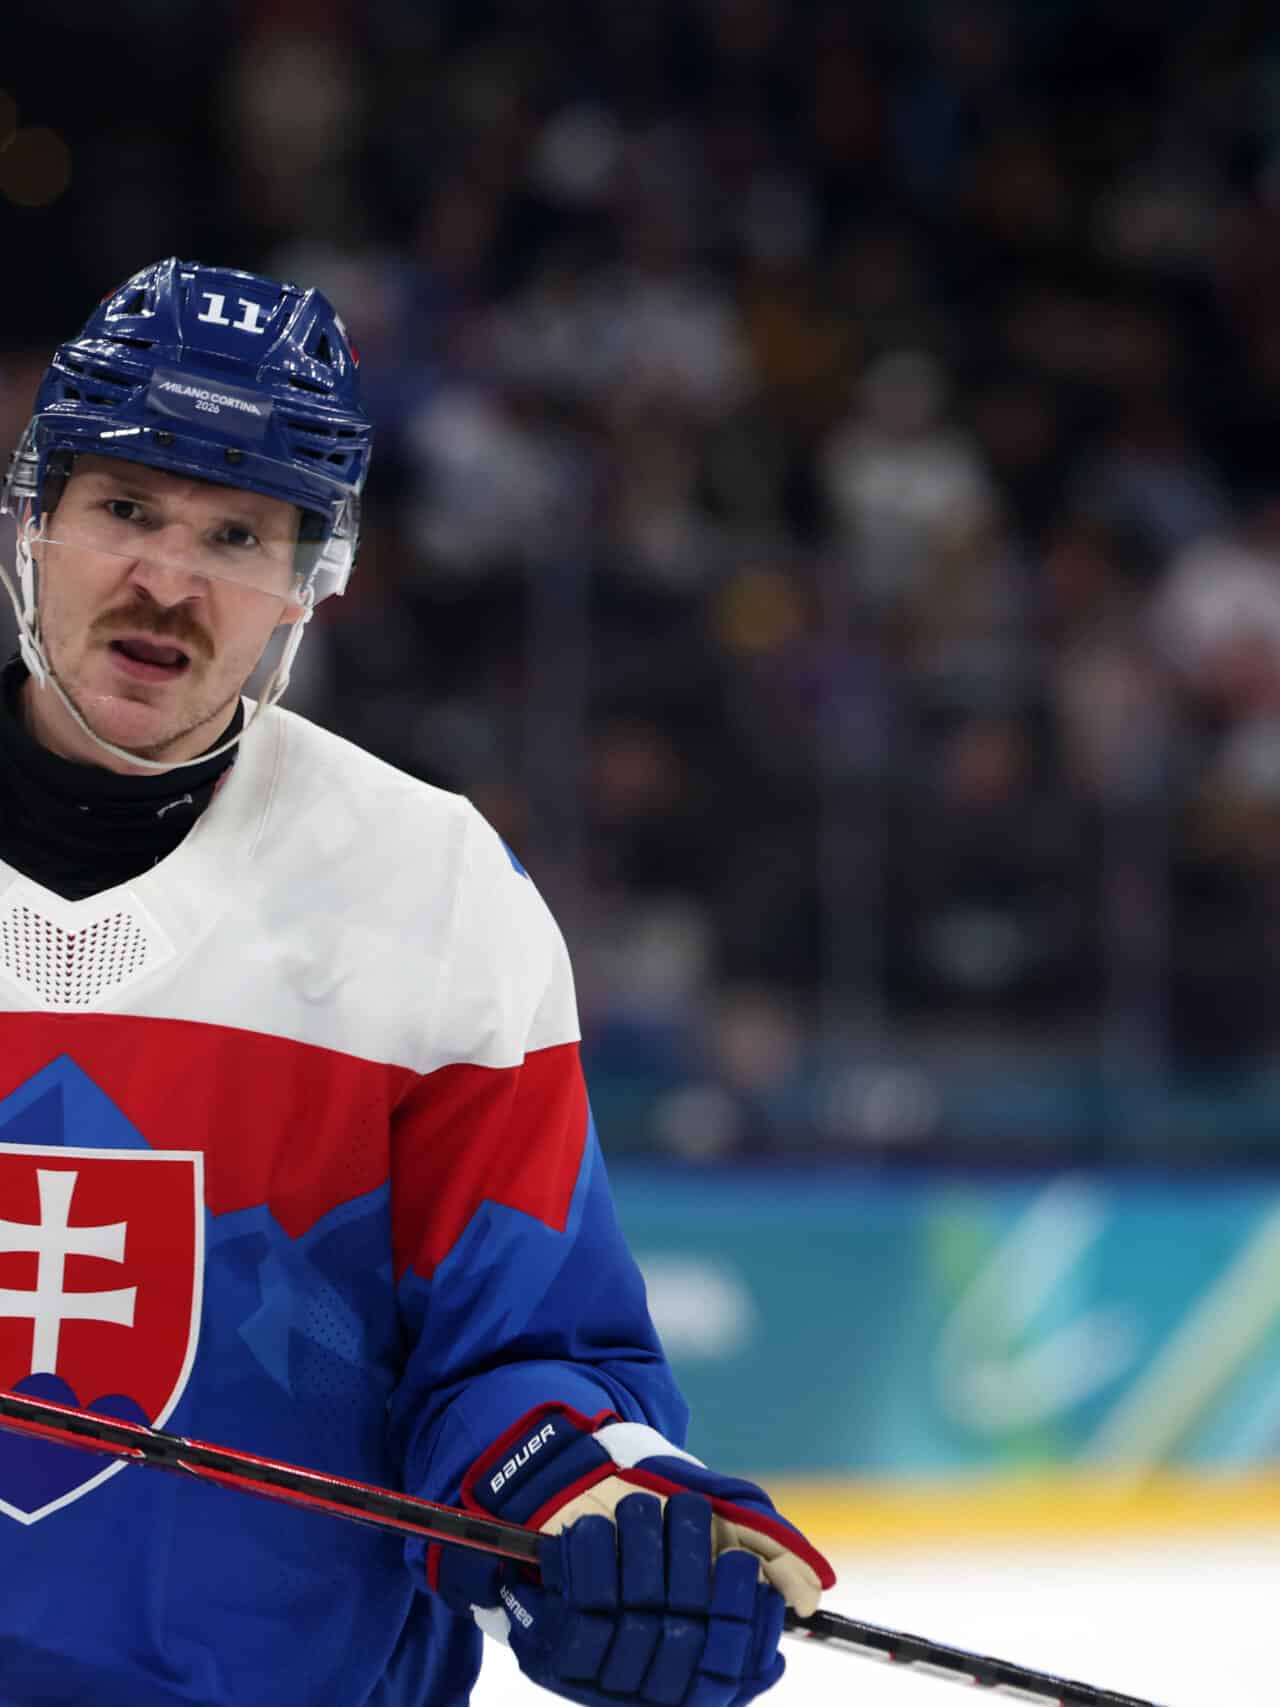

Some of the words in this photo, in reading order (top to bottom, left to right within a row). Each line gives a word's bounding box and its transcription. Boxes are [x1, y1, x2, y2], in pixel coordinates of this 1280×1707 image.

[198, 292, 264, 333] 11
[159, 382, 209, 399] MILANO
[210, 394, 261, 415] CORTINA
[195, 400, 220, 414] 2026
